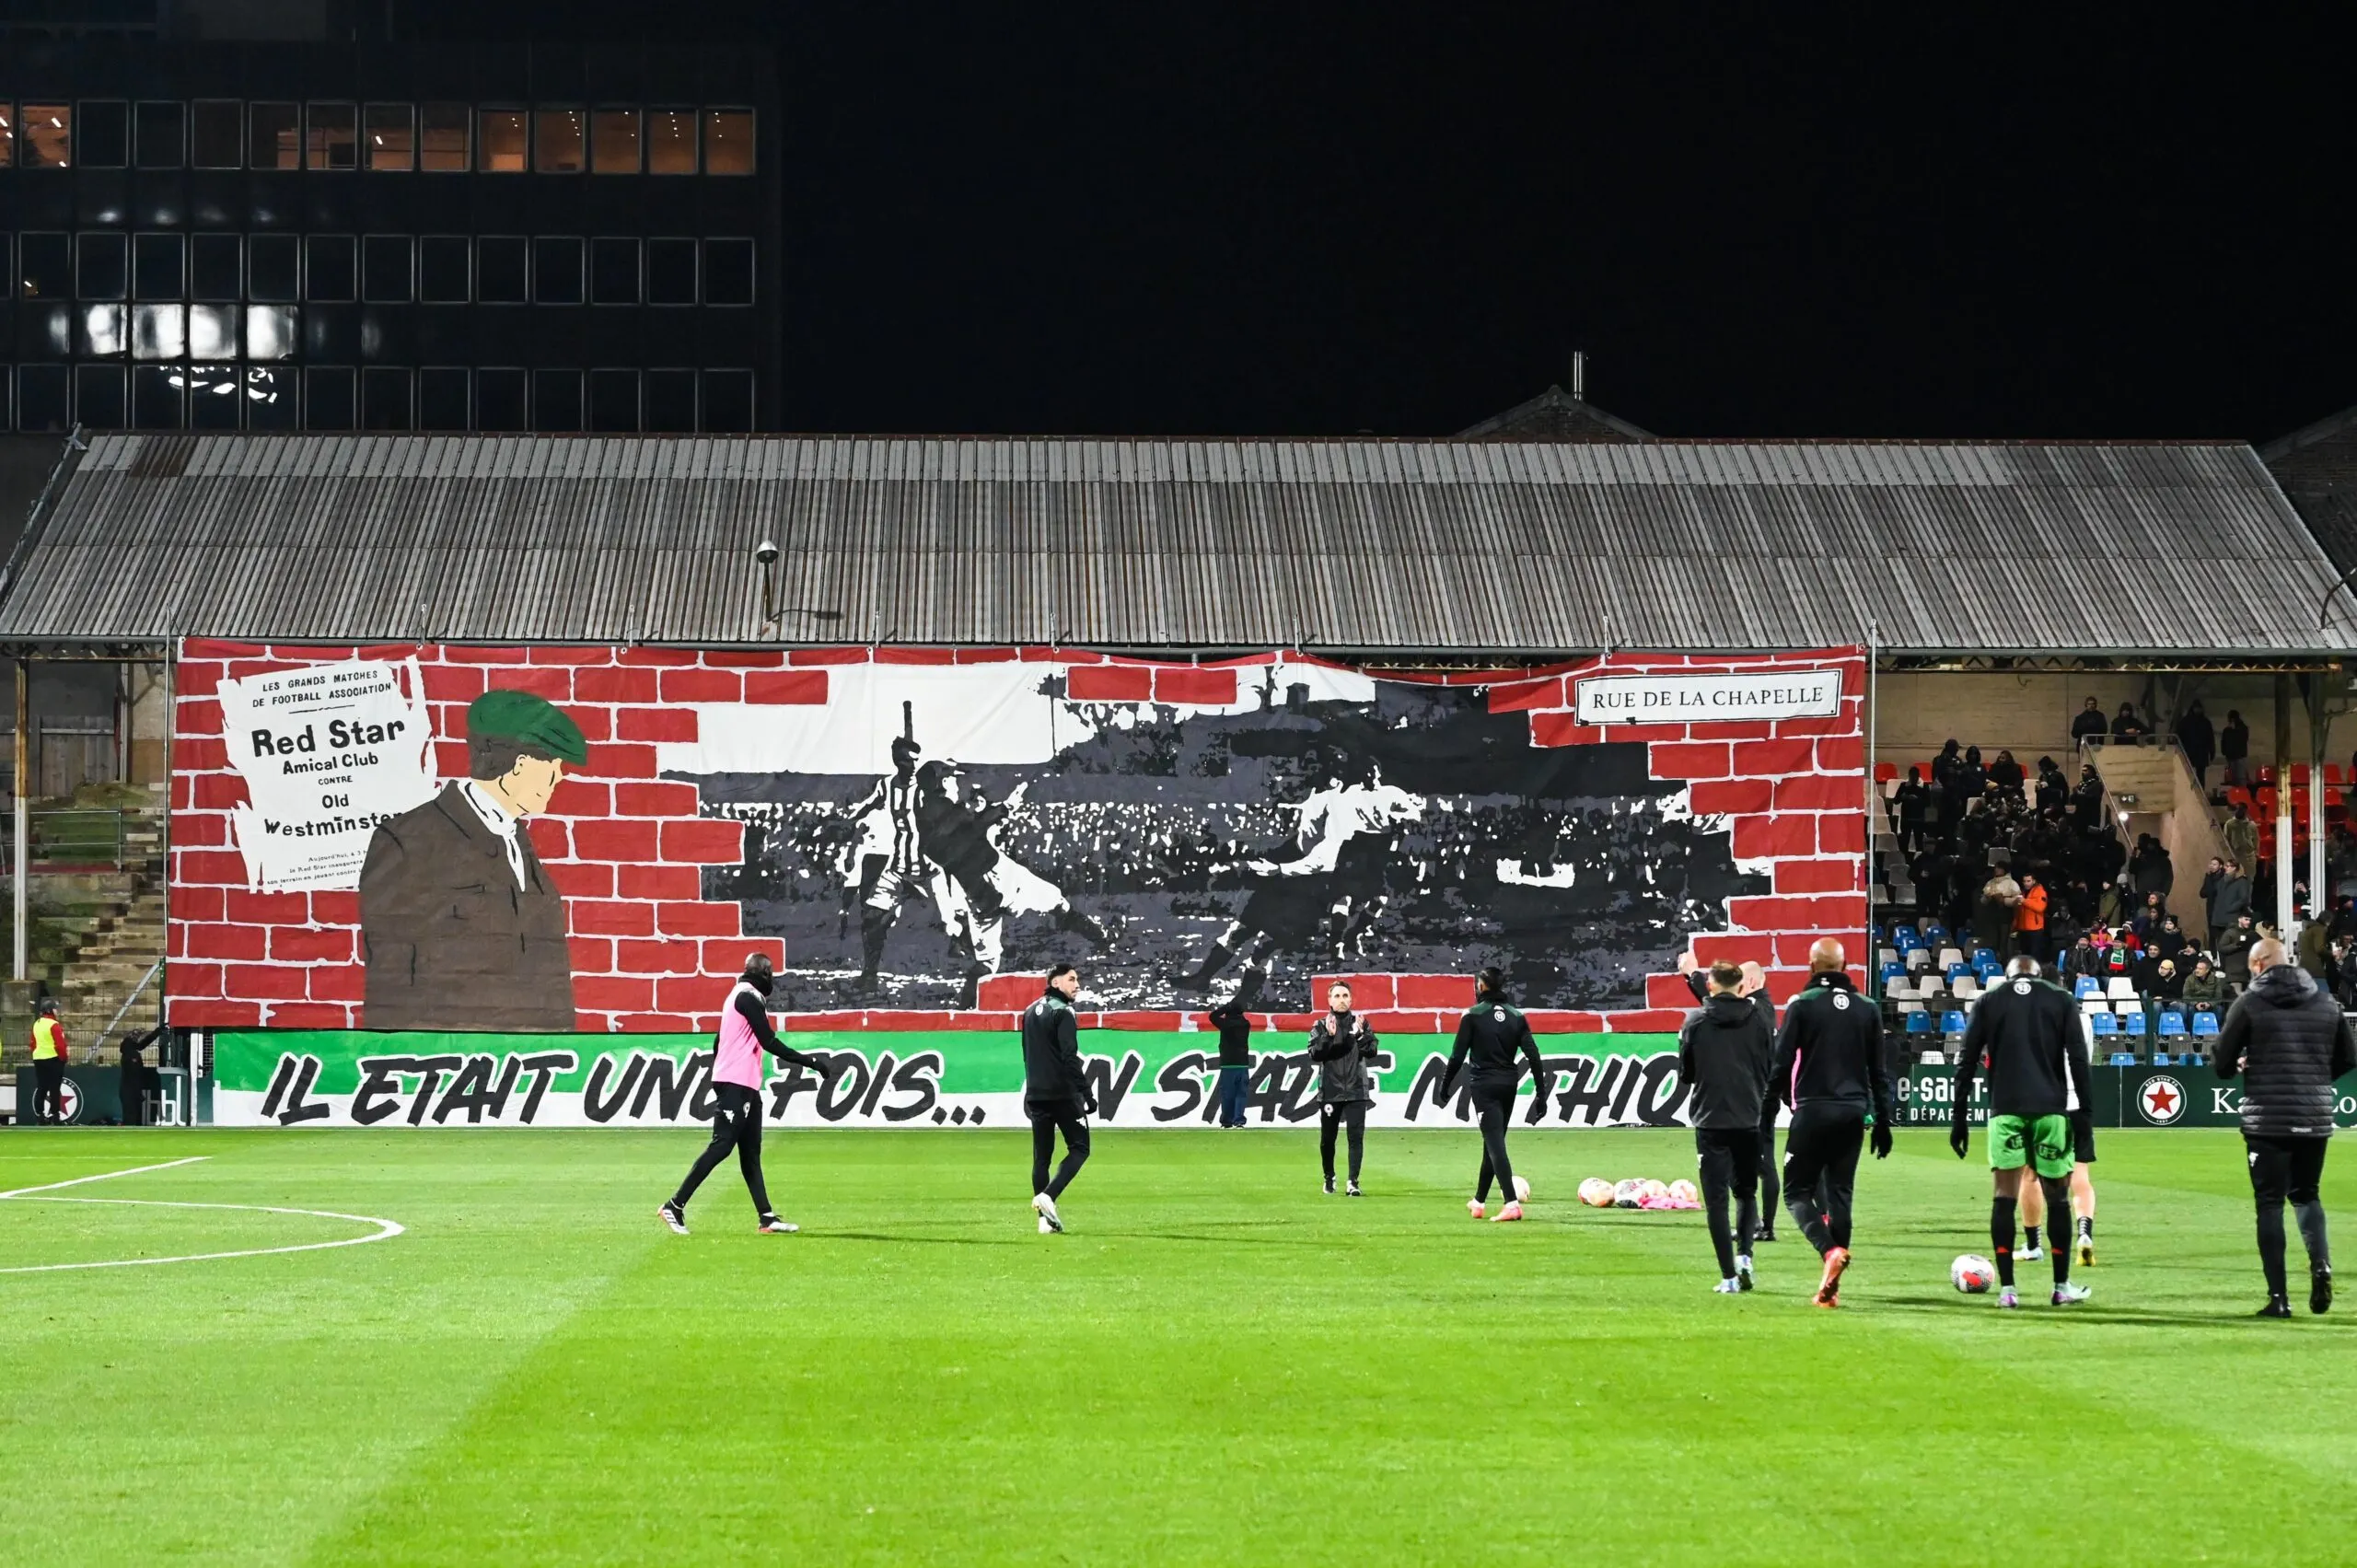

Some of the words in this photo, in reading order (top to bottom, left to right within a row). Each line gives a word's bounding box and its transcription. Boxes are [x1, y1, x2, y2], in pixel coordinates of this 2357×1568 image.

[262, 681, 280, 692] LES
[288, 675, 326, 689] GRANDS
[333, 670, 377, 683] MATCHES
[252, 698, 265, 708] DE
[272, 691, 321, 705] FOOTBALL
[329, 682, 391, 699] ASSOCIATION
[1593, 692, 1635, 709] RUE
[1643, 691, 1672, 707] DE
[1679, 691, 1704, 706] LA
[1713, 687, 1823, 706] CHAPELLE
[251, 725, 316, 758] Red
[329, 719, 405, 749] Star
[283, 756, 338, 774] Amical
[342, 752, 378, 768] Club
[318, 775, 353, 785] CONTRE
[322, 794, 349, 808] Old
[260, 1054, 330, 1126] IL
[351, 1054, 575, 1124] ETAIT
